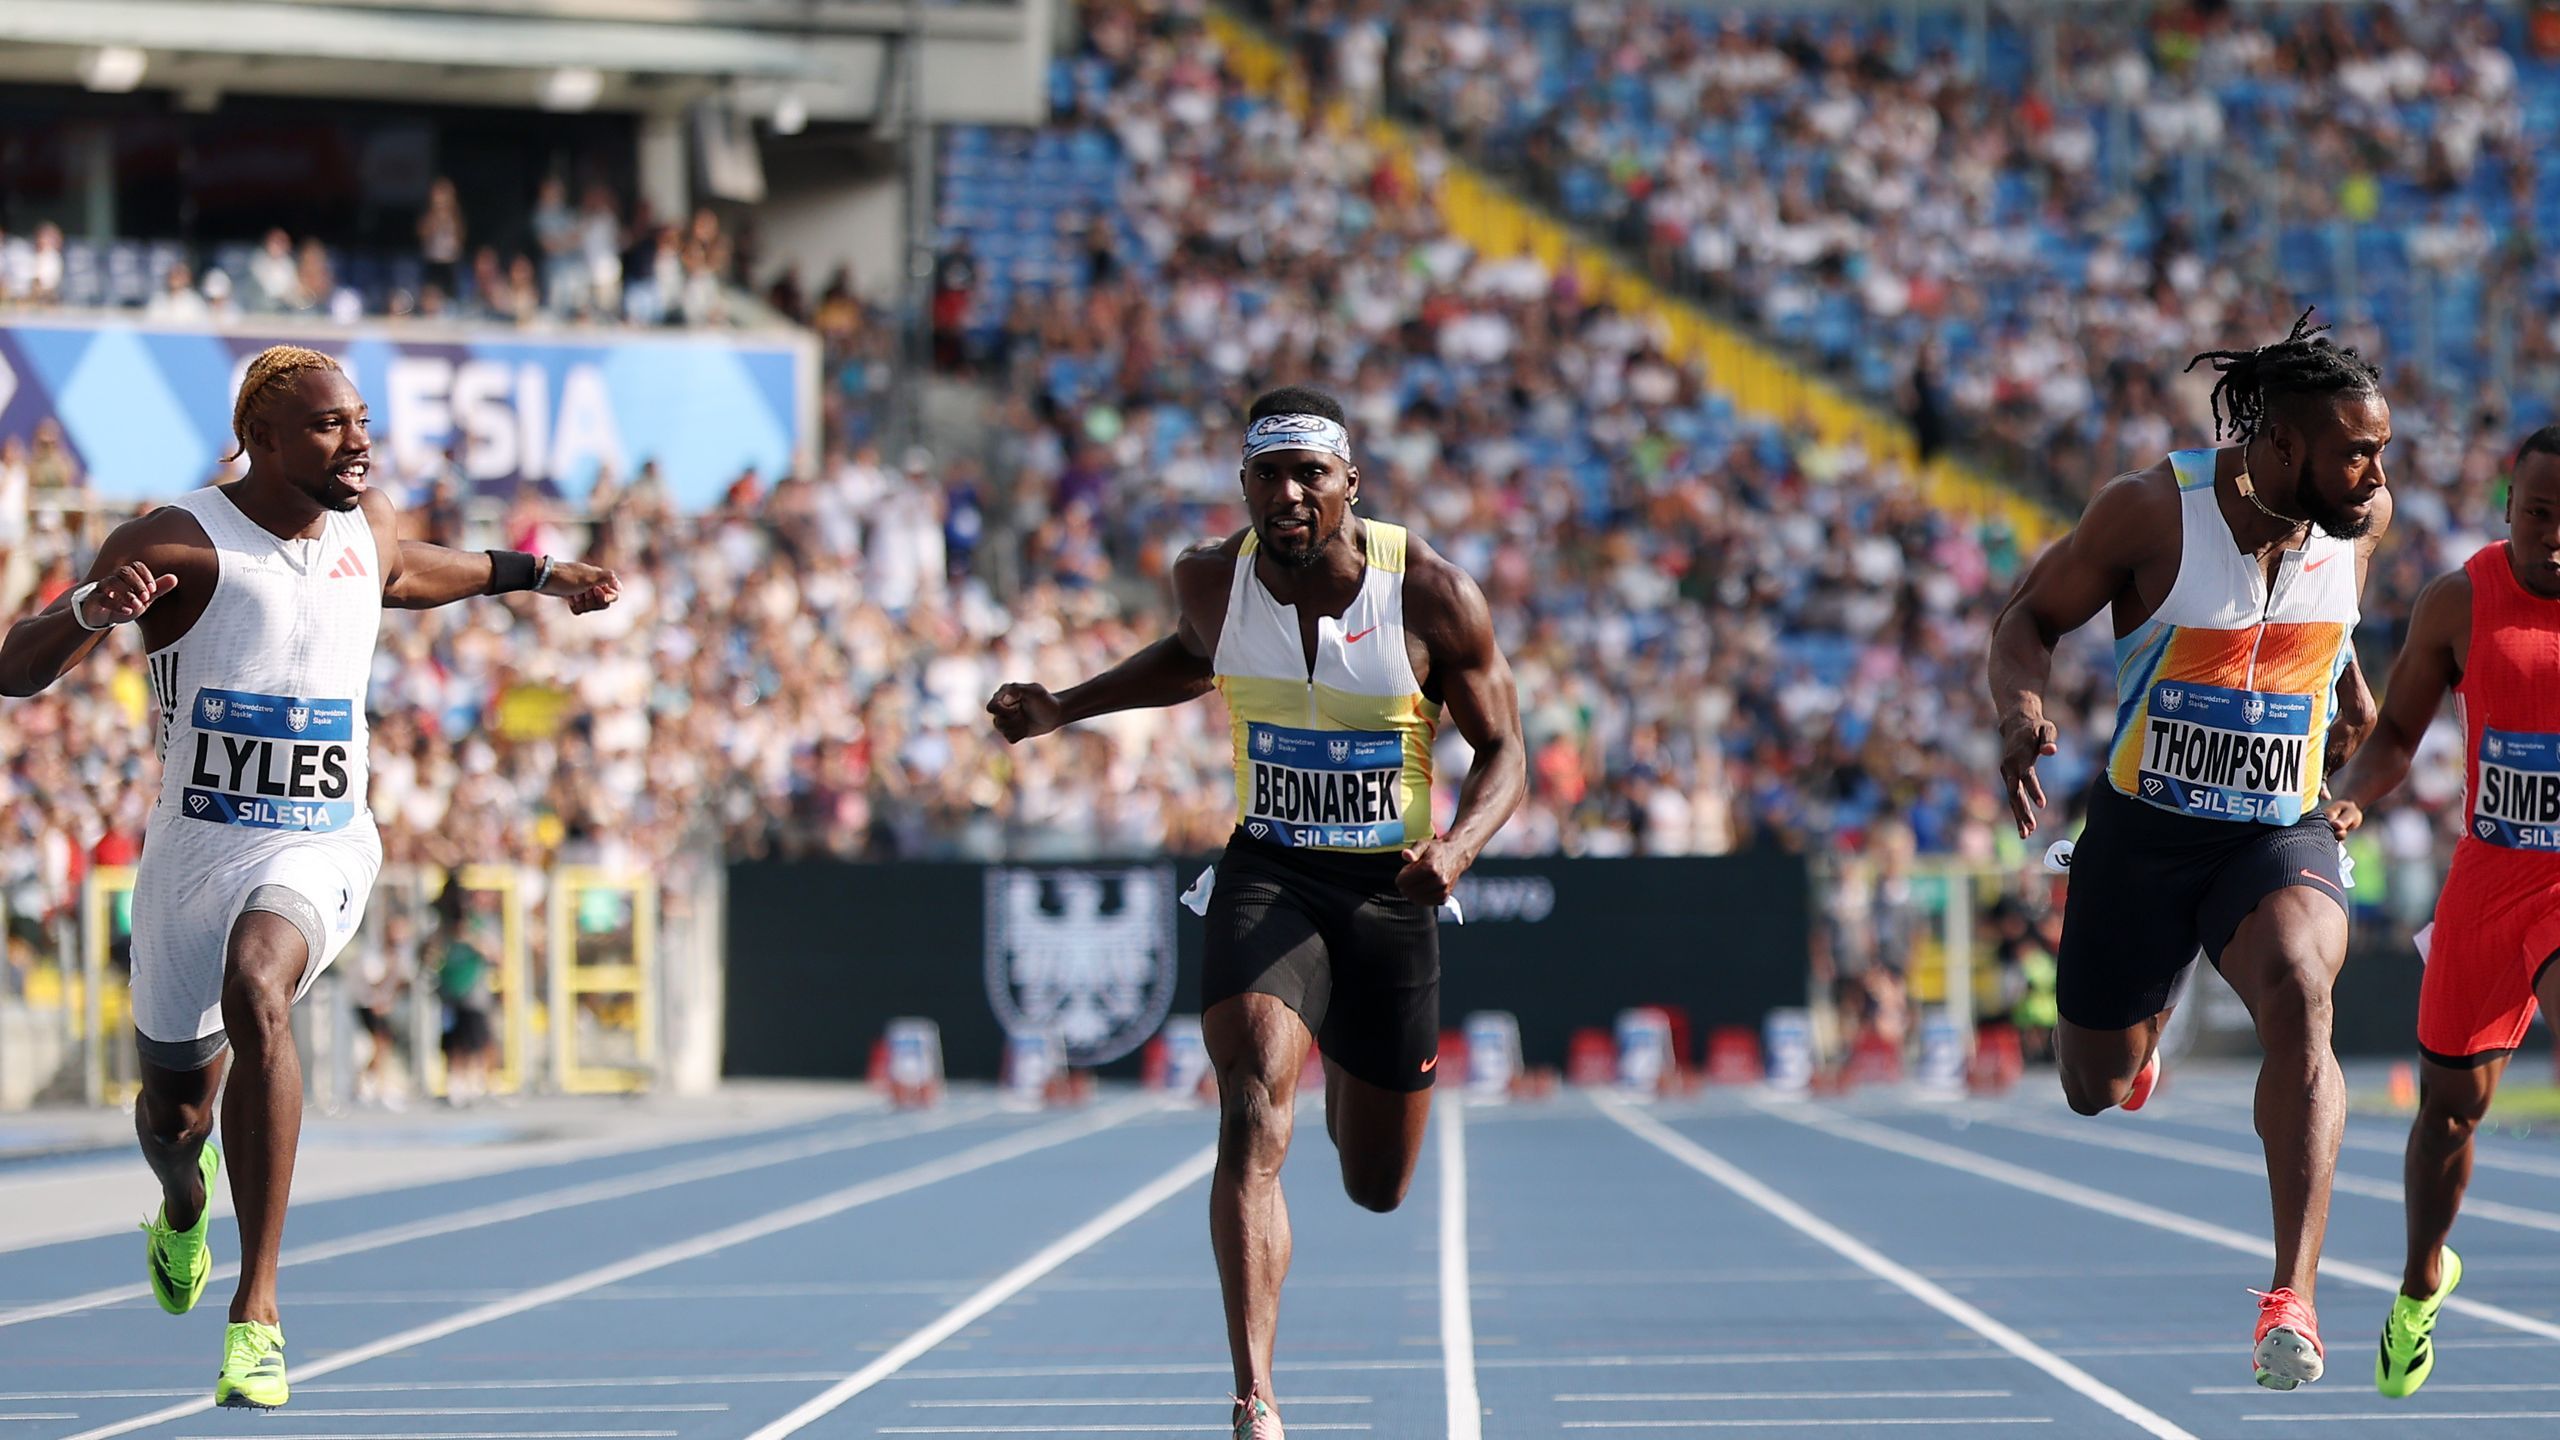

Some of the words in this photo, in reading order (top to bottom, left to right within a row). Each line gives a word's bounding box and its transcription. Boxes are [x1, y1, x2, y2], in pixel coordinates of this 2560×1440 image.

[230, 354, 636, 482] ESIA
[192, 732, 348, 799] LYLES
[2151, 720, 2303, 793] THOMPSON
[238, 802, 331, 827] SILESIA
[1254, 763, 1399, 824] BEDNAREK
[2189, 789, 2280, 820] SILESIA
[2483, 766, 2560, 822] SIMB
[1293, 829, 1382, 848] SILESIA
